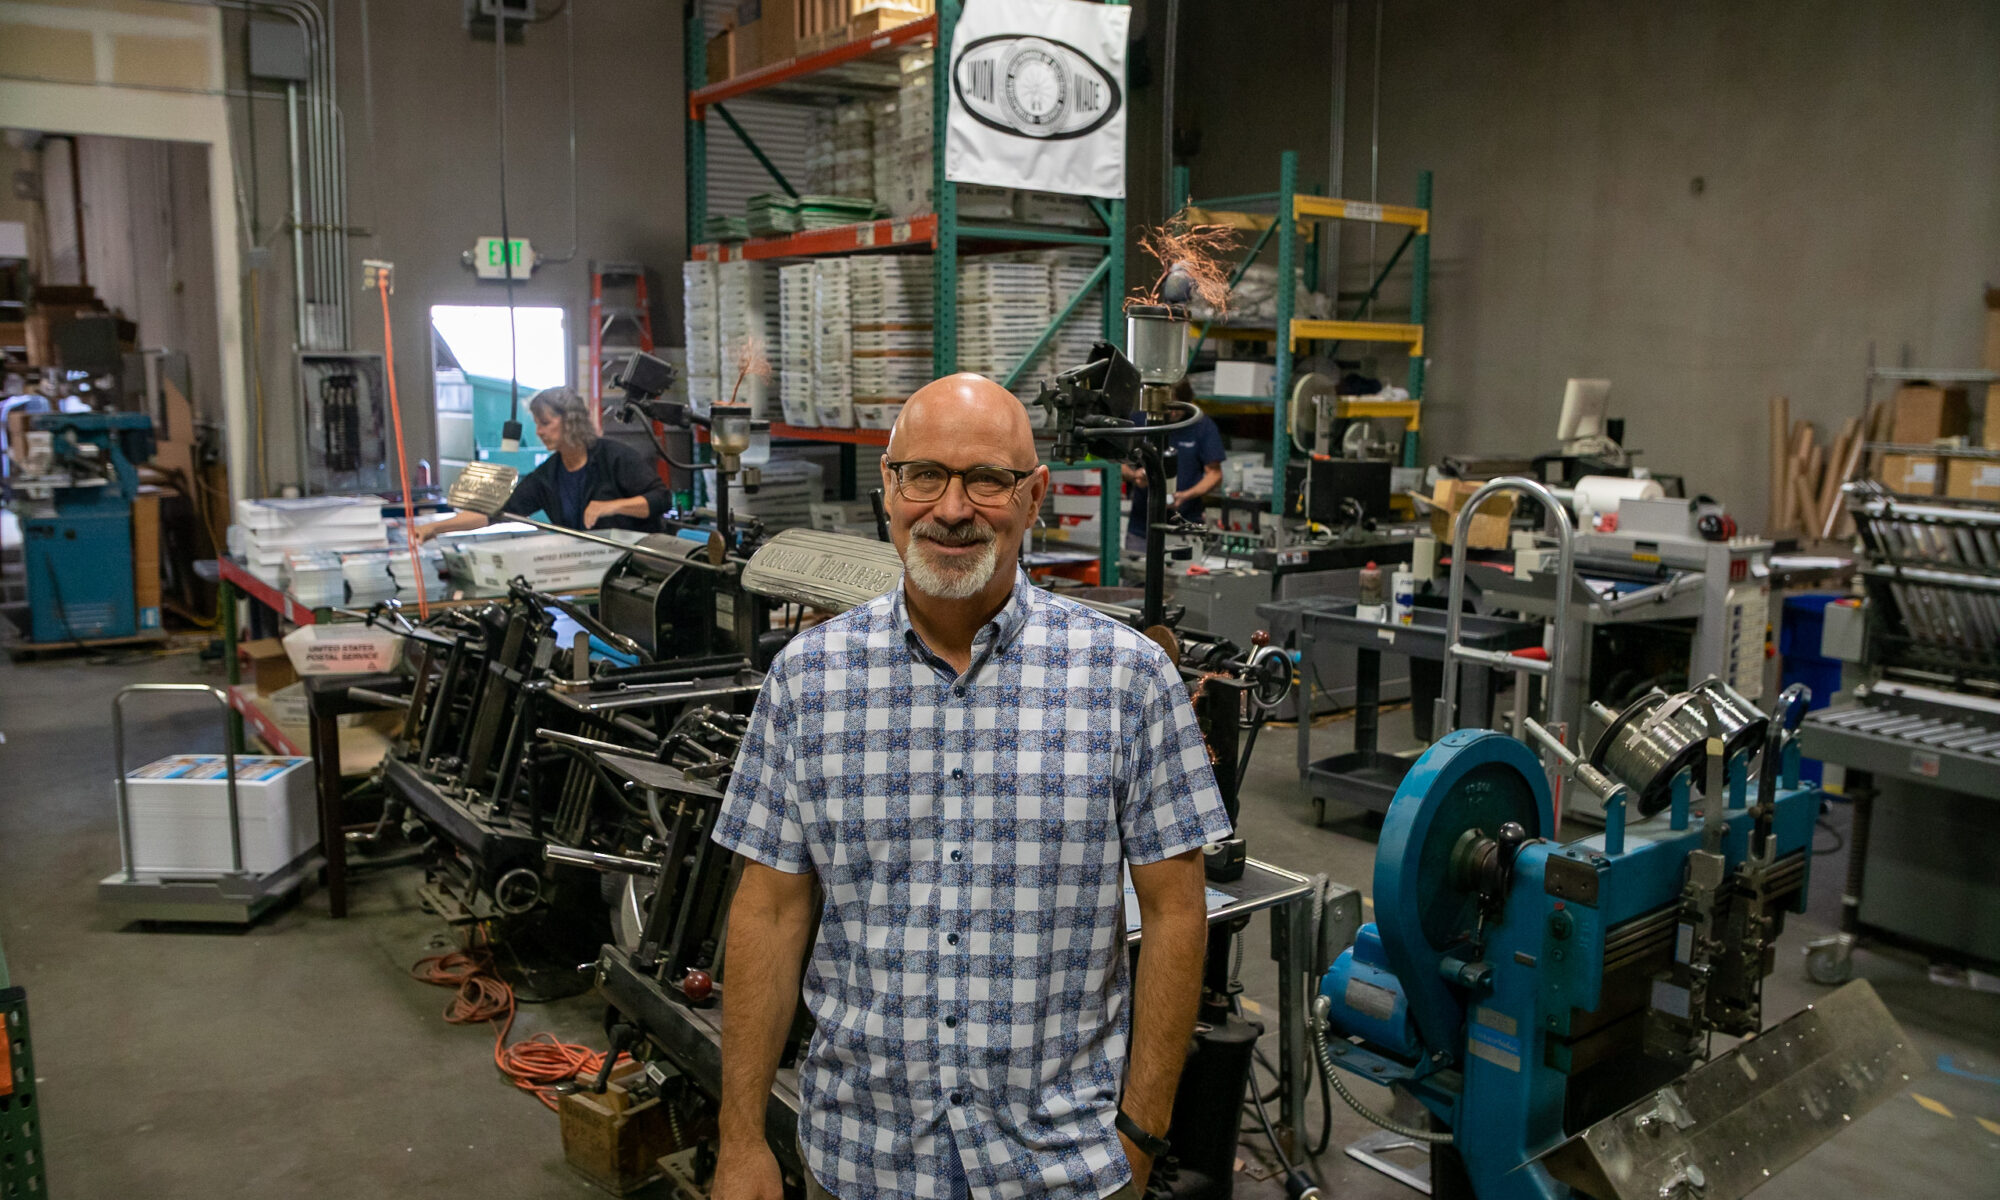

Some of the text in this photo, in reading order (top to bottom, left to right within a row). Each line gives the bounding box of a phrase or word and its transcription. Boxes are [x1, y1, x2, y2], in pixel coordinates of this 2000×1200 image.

[533, 555, 557, 563] UNITED
[559, 552, 581, 560] STATES
[760, 548, 894, 593] ORIGINAL HEIDELBERG
[308, 644, 375, 652] UNITED STATES
[306, 652, 378, 661] POSTAL SERVICE
